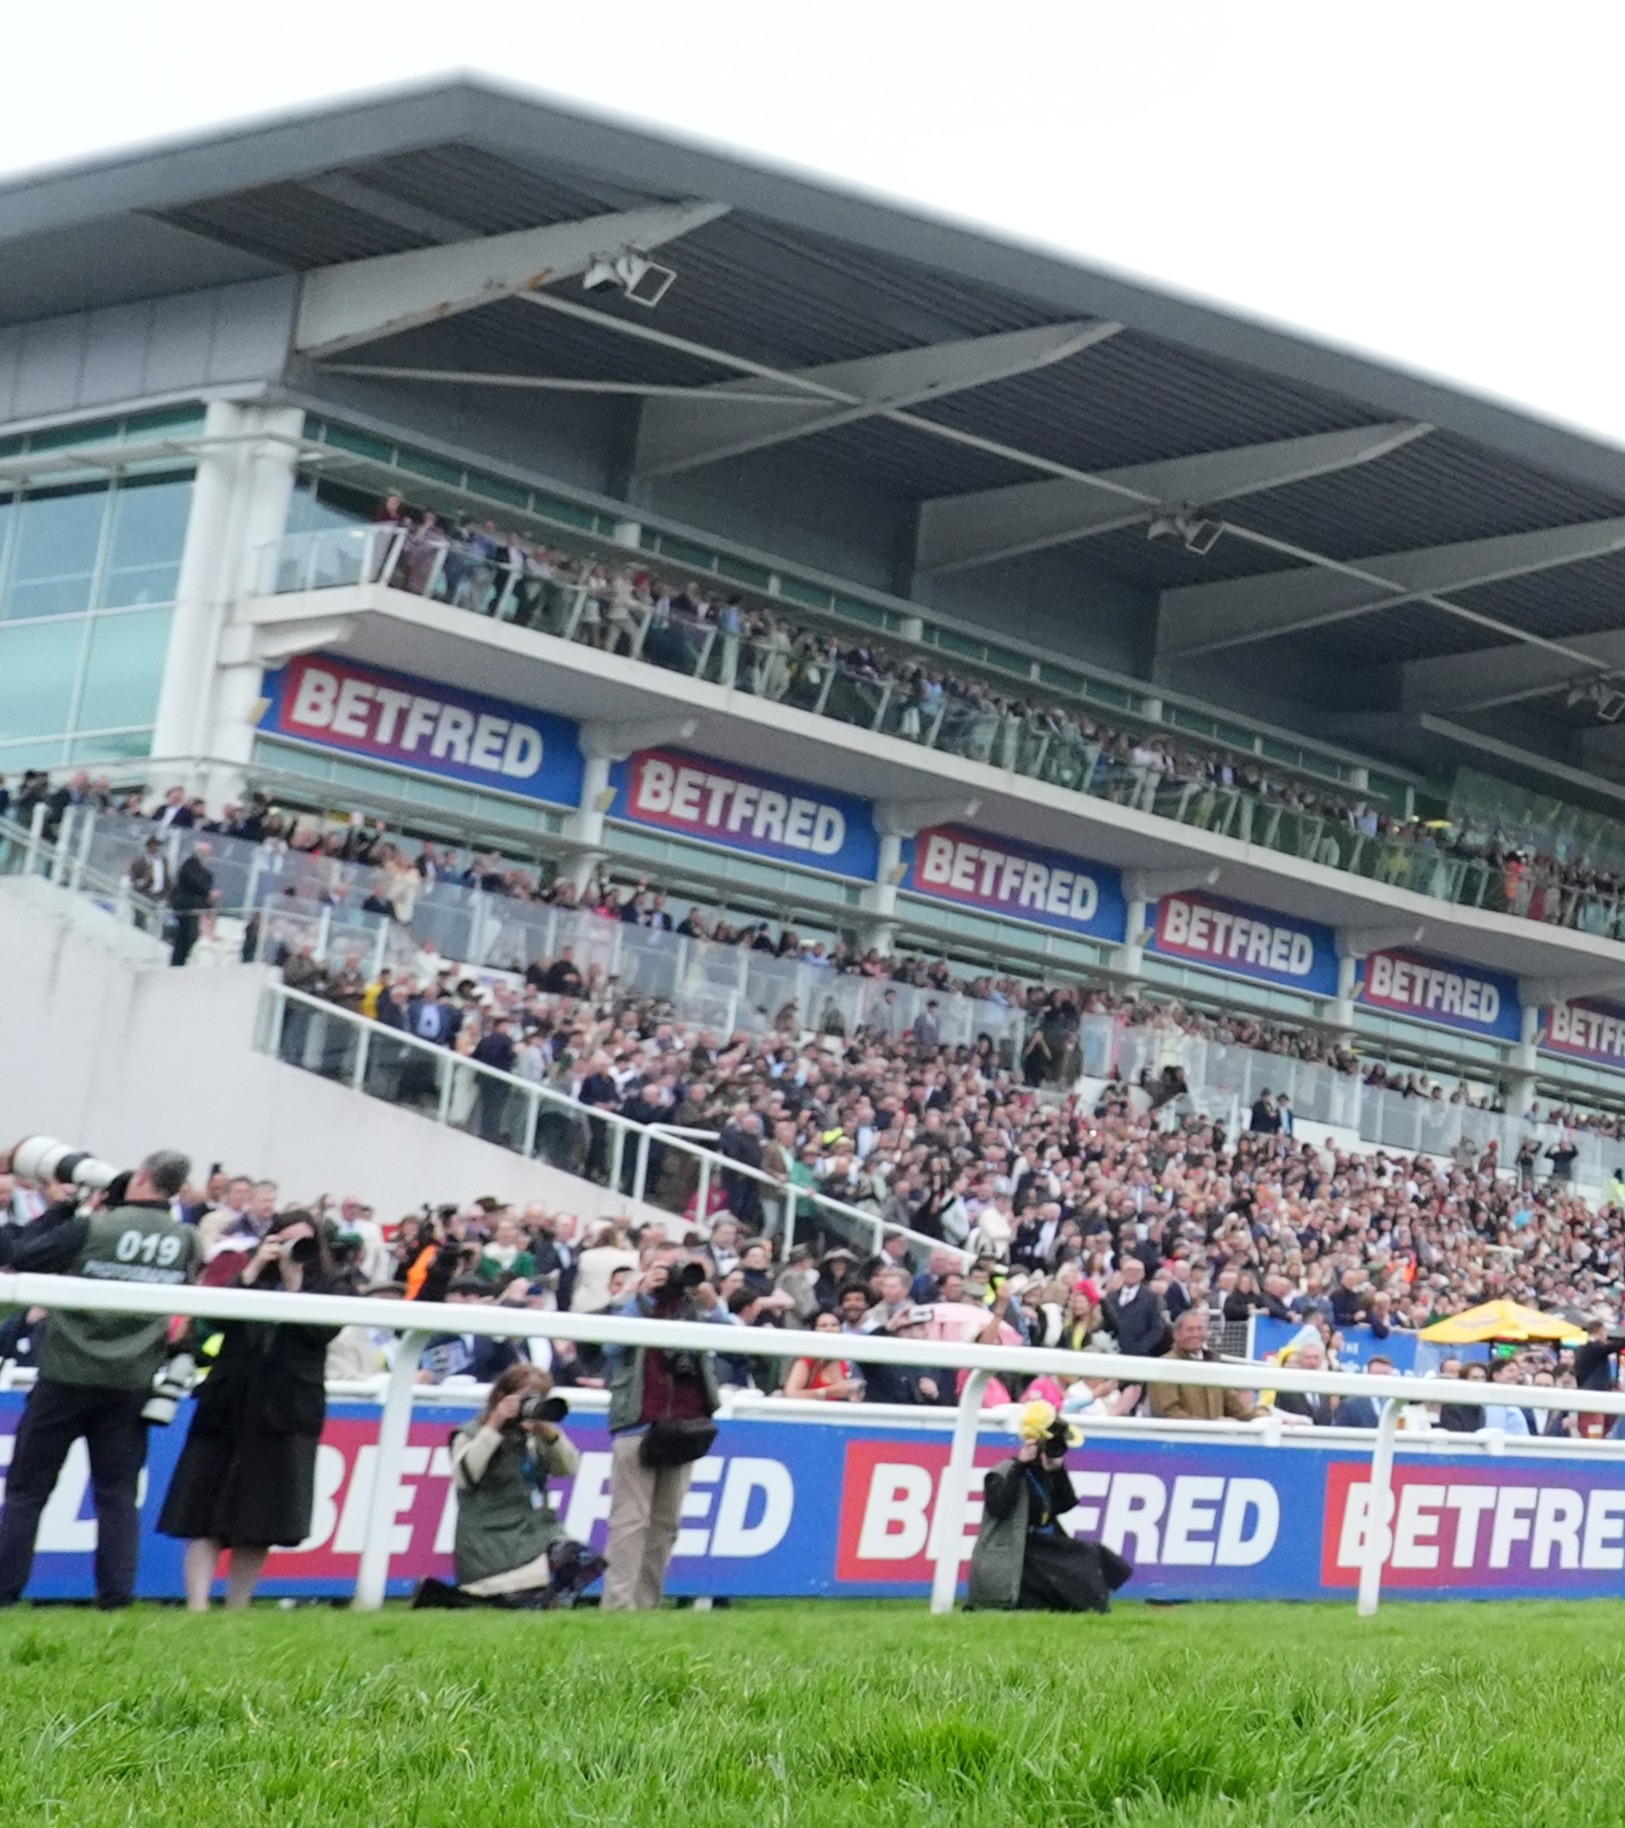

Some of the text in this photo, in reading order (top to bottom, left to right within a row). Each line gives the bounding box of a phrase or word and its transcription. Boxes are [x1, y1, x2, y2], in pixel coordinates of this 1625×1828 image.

[291, 668, 544, 779] BETFRED
[638, 758, 846, 855] BETFRED
[921, 834, 1099, 921] BETFRED
[1162, 899, 1313, 976] BETFRED
[1368, 955, 1500, 1024] BETFRED
[116, 1230, 181, 1266] 019
[857, 1463, 1280, 1567] BEFRED
